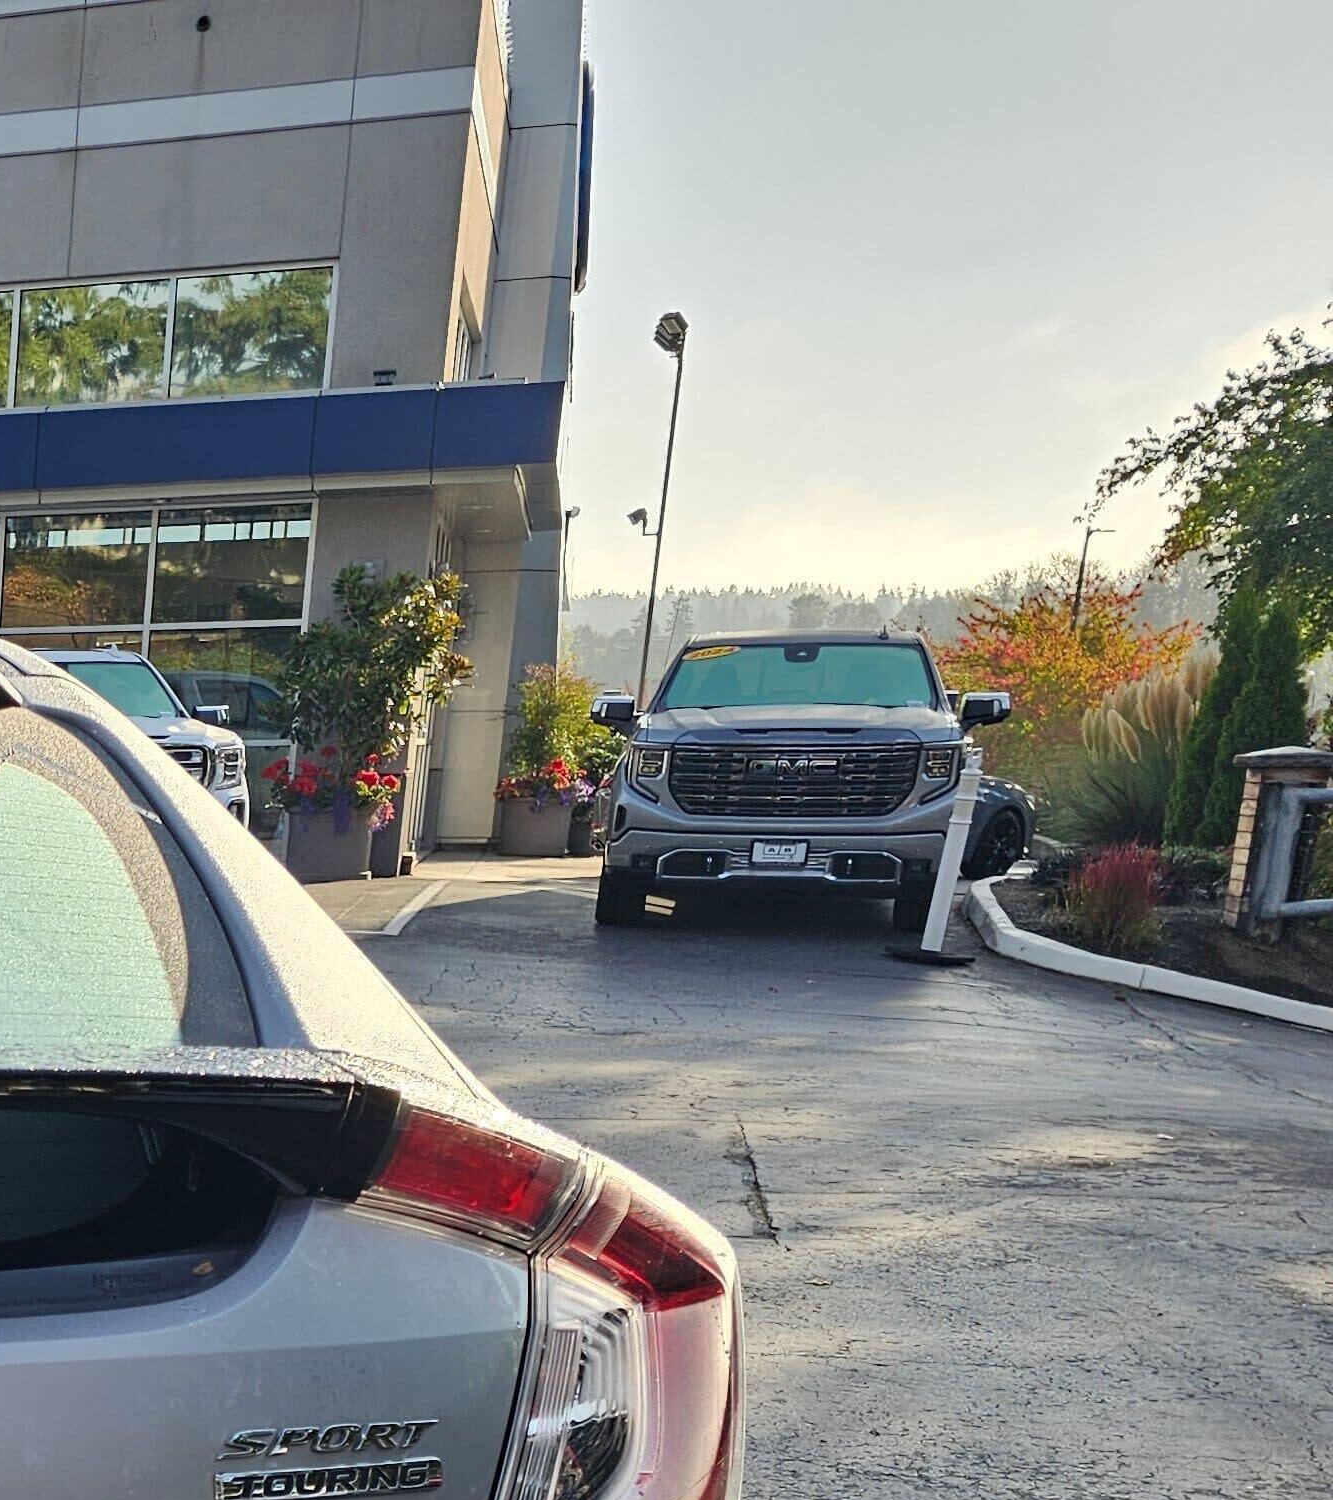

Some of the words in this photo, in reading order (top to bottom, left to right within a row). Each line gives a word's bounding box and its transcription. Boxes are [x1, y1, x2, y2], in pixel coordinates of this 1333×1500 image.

[749, 759, 838, 776] GMC
[216, 1418, 439, 1461] SPORT
[225, 1461, 431, 1499] TOURING
